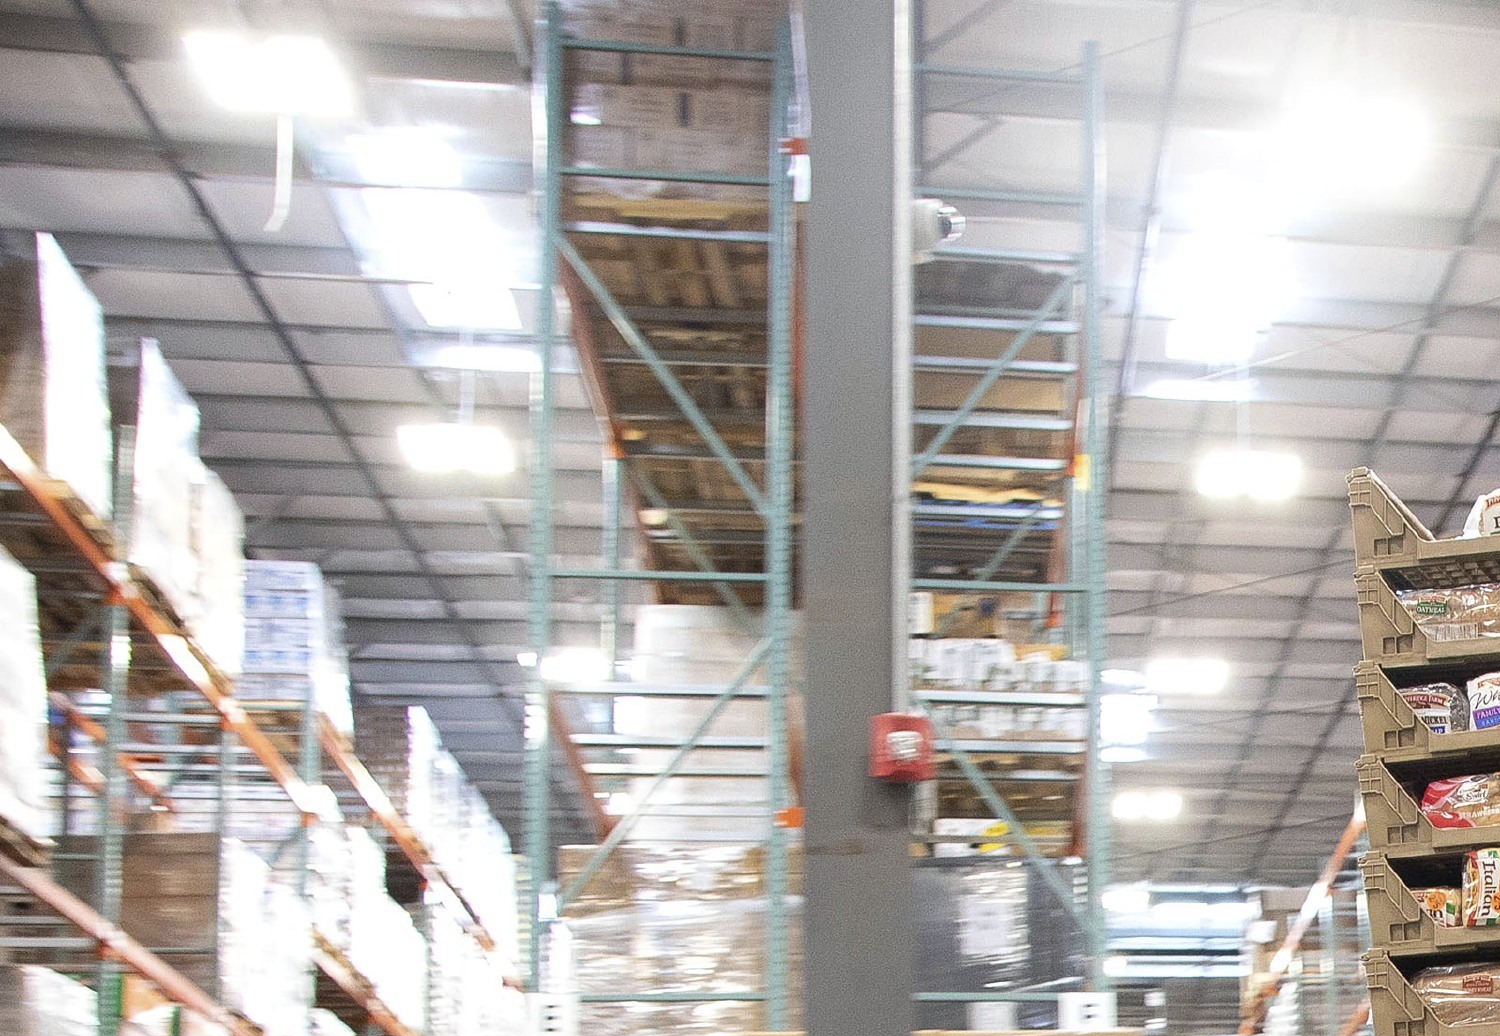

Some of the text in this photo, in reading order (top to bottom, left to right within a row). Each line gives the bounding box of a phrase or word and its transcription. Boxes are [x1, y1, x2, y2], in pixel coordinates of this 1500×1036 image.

[1417, 606, 1446, 614] OATMEAL
[1476, 707, 1500, 720] FAMILY
[1481, 860, 1498, 917] Italian
